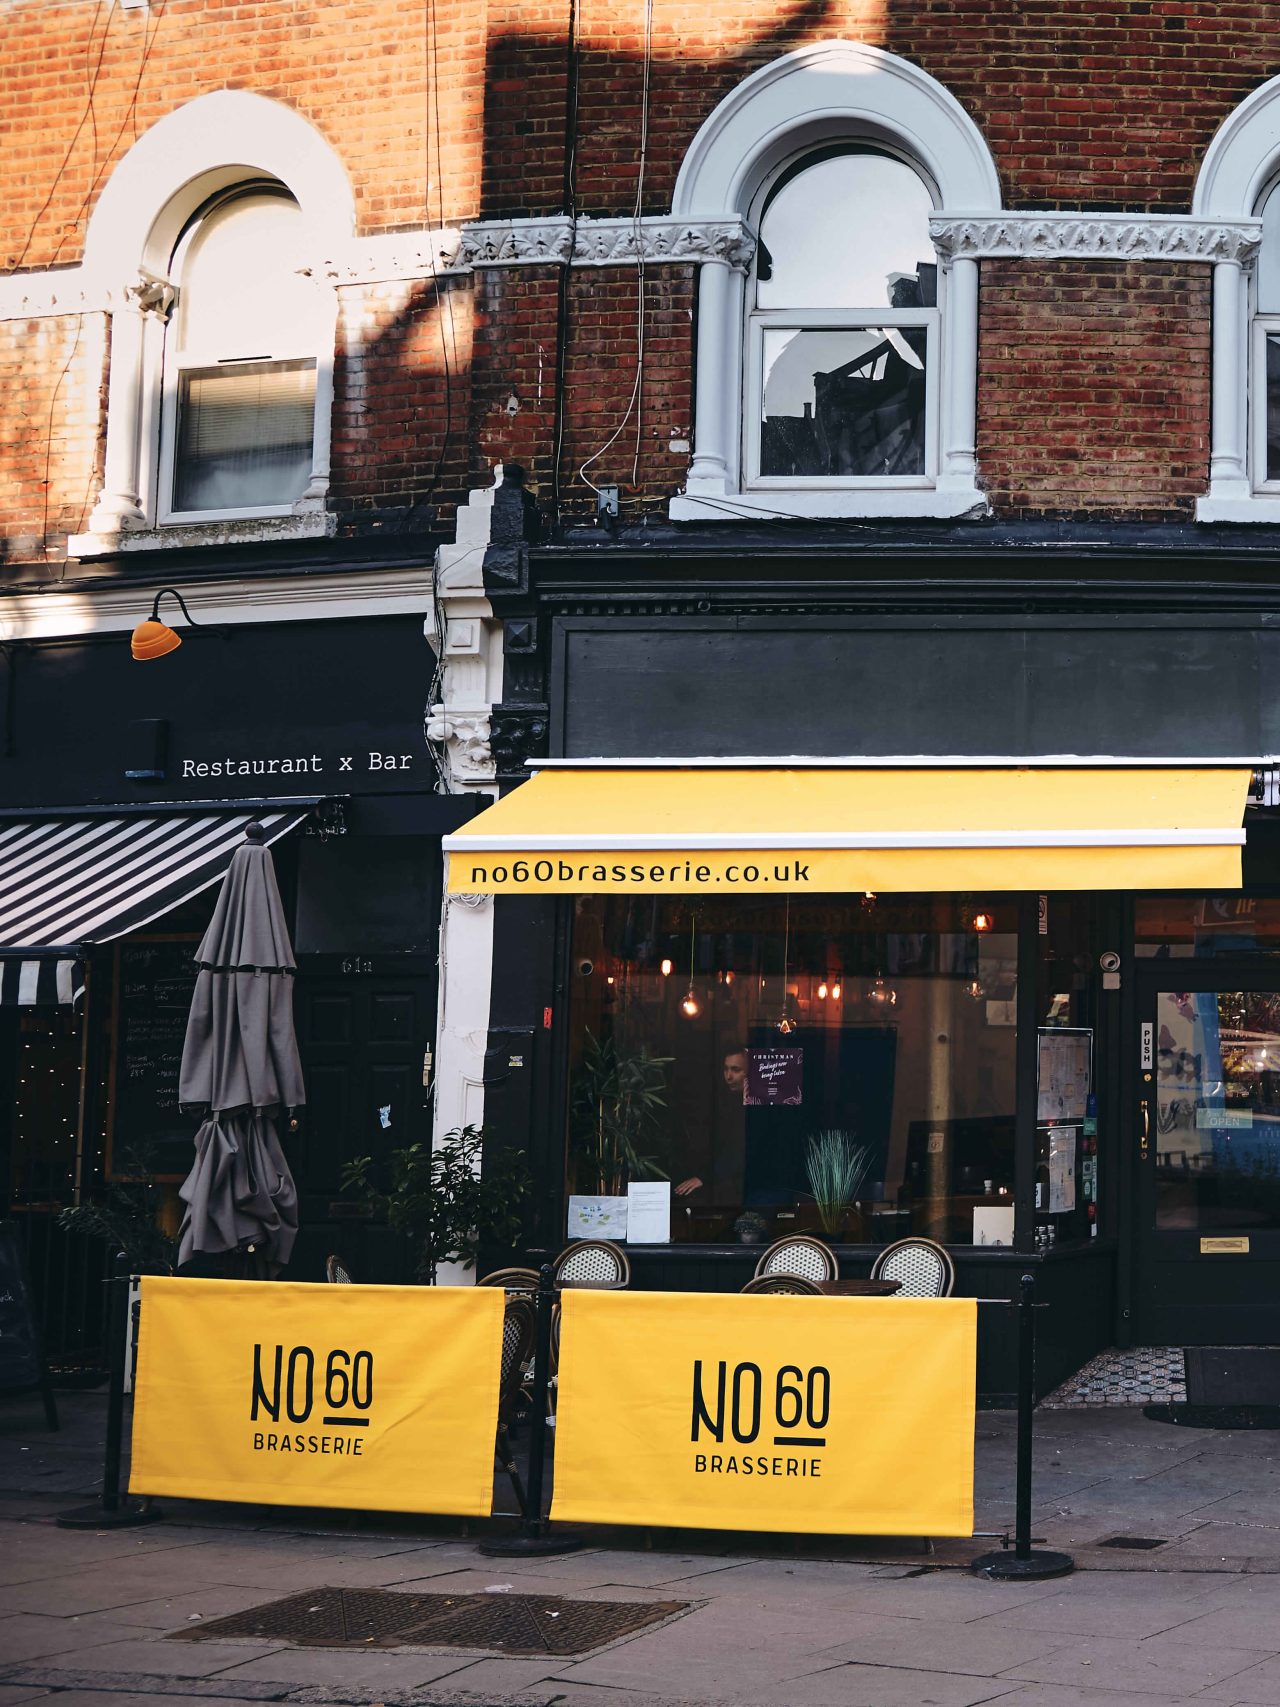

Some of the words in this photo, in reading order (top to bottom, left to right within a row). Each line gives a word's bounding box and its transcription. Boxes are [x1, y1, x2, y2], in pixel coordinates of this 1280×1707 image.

[182, 754, 323, 778] Restaurant
[338, 756, 353, 771] x
[368, 752, 413, 771] Bar
[471, 860, 810, 883] no60brasserie.co.uk
[1143, 1030, 1151, 1062] PUSH
[1209, 1117, 1240, 1127] OPEN
[251, 1344, 314, 1424] NO
[325, 1349, 373, 1410] 60
[691, 1360, 761, 1444] NO
[775, 1365, 830, 1429] 60
[253, 1433, 364, 1456] BRASSERIE
[695, 1454, 821, 1477] BRASSERIE
